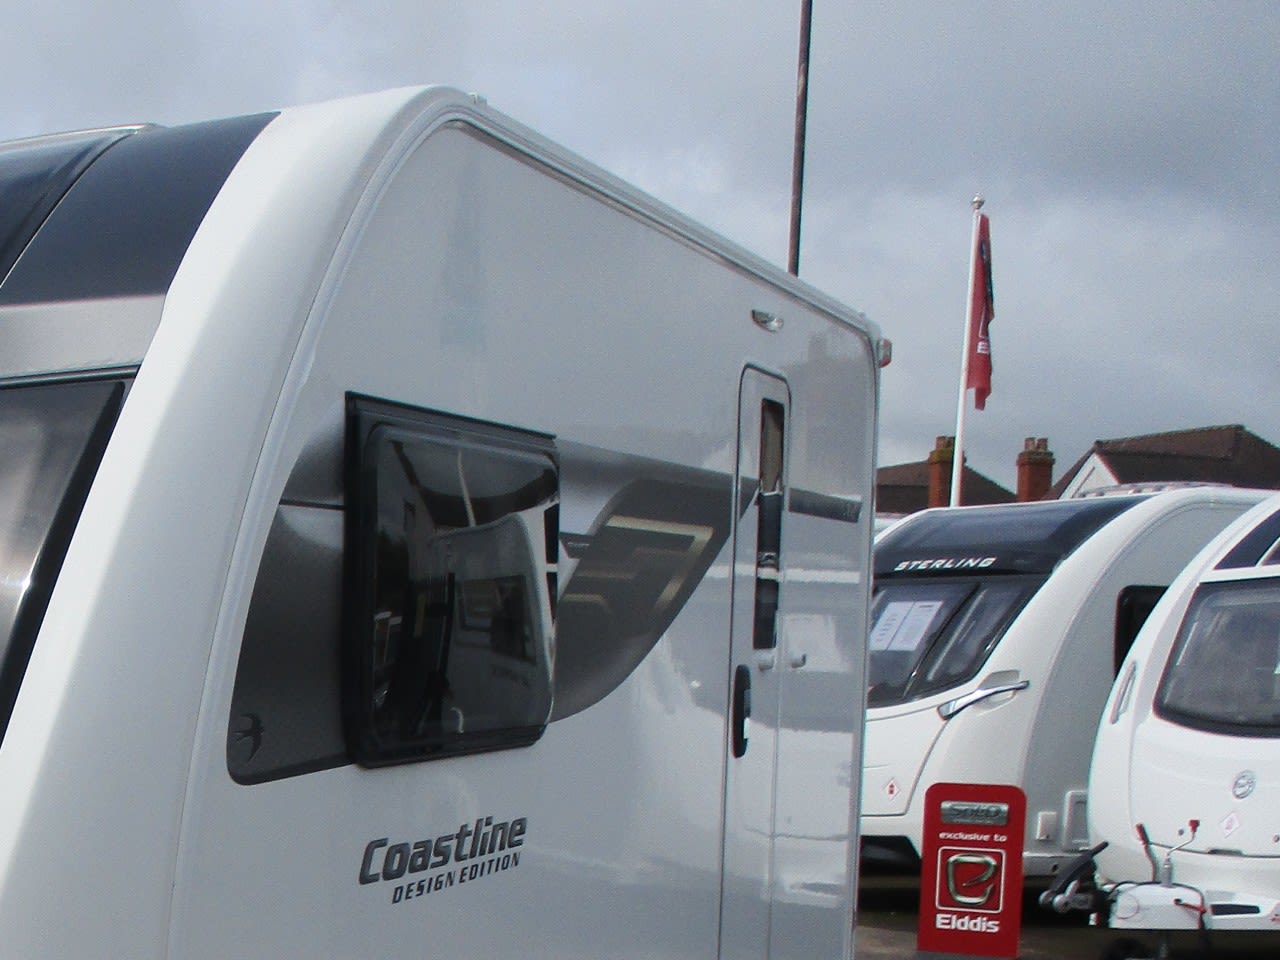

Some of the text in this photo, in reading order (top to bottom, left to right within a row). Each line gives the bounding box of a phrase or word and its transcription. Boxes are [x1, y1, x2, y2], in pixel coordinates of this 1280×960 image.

[893, 557, 998, 572] STERLING
[938, 831, 1008, 843] exclusive to
[358, 815, 528, 886] Coastline
[391, 851, 521, 905] DESIGN EDITION
[935, 913, 1001, 934] Elddis
